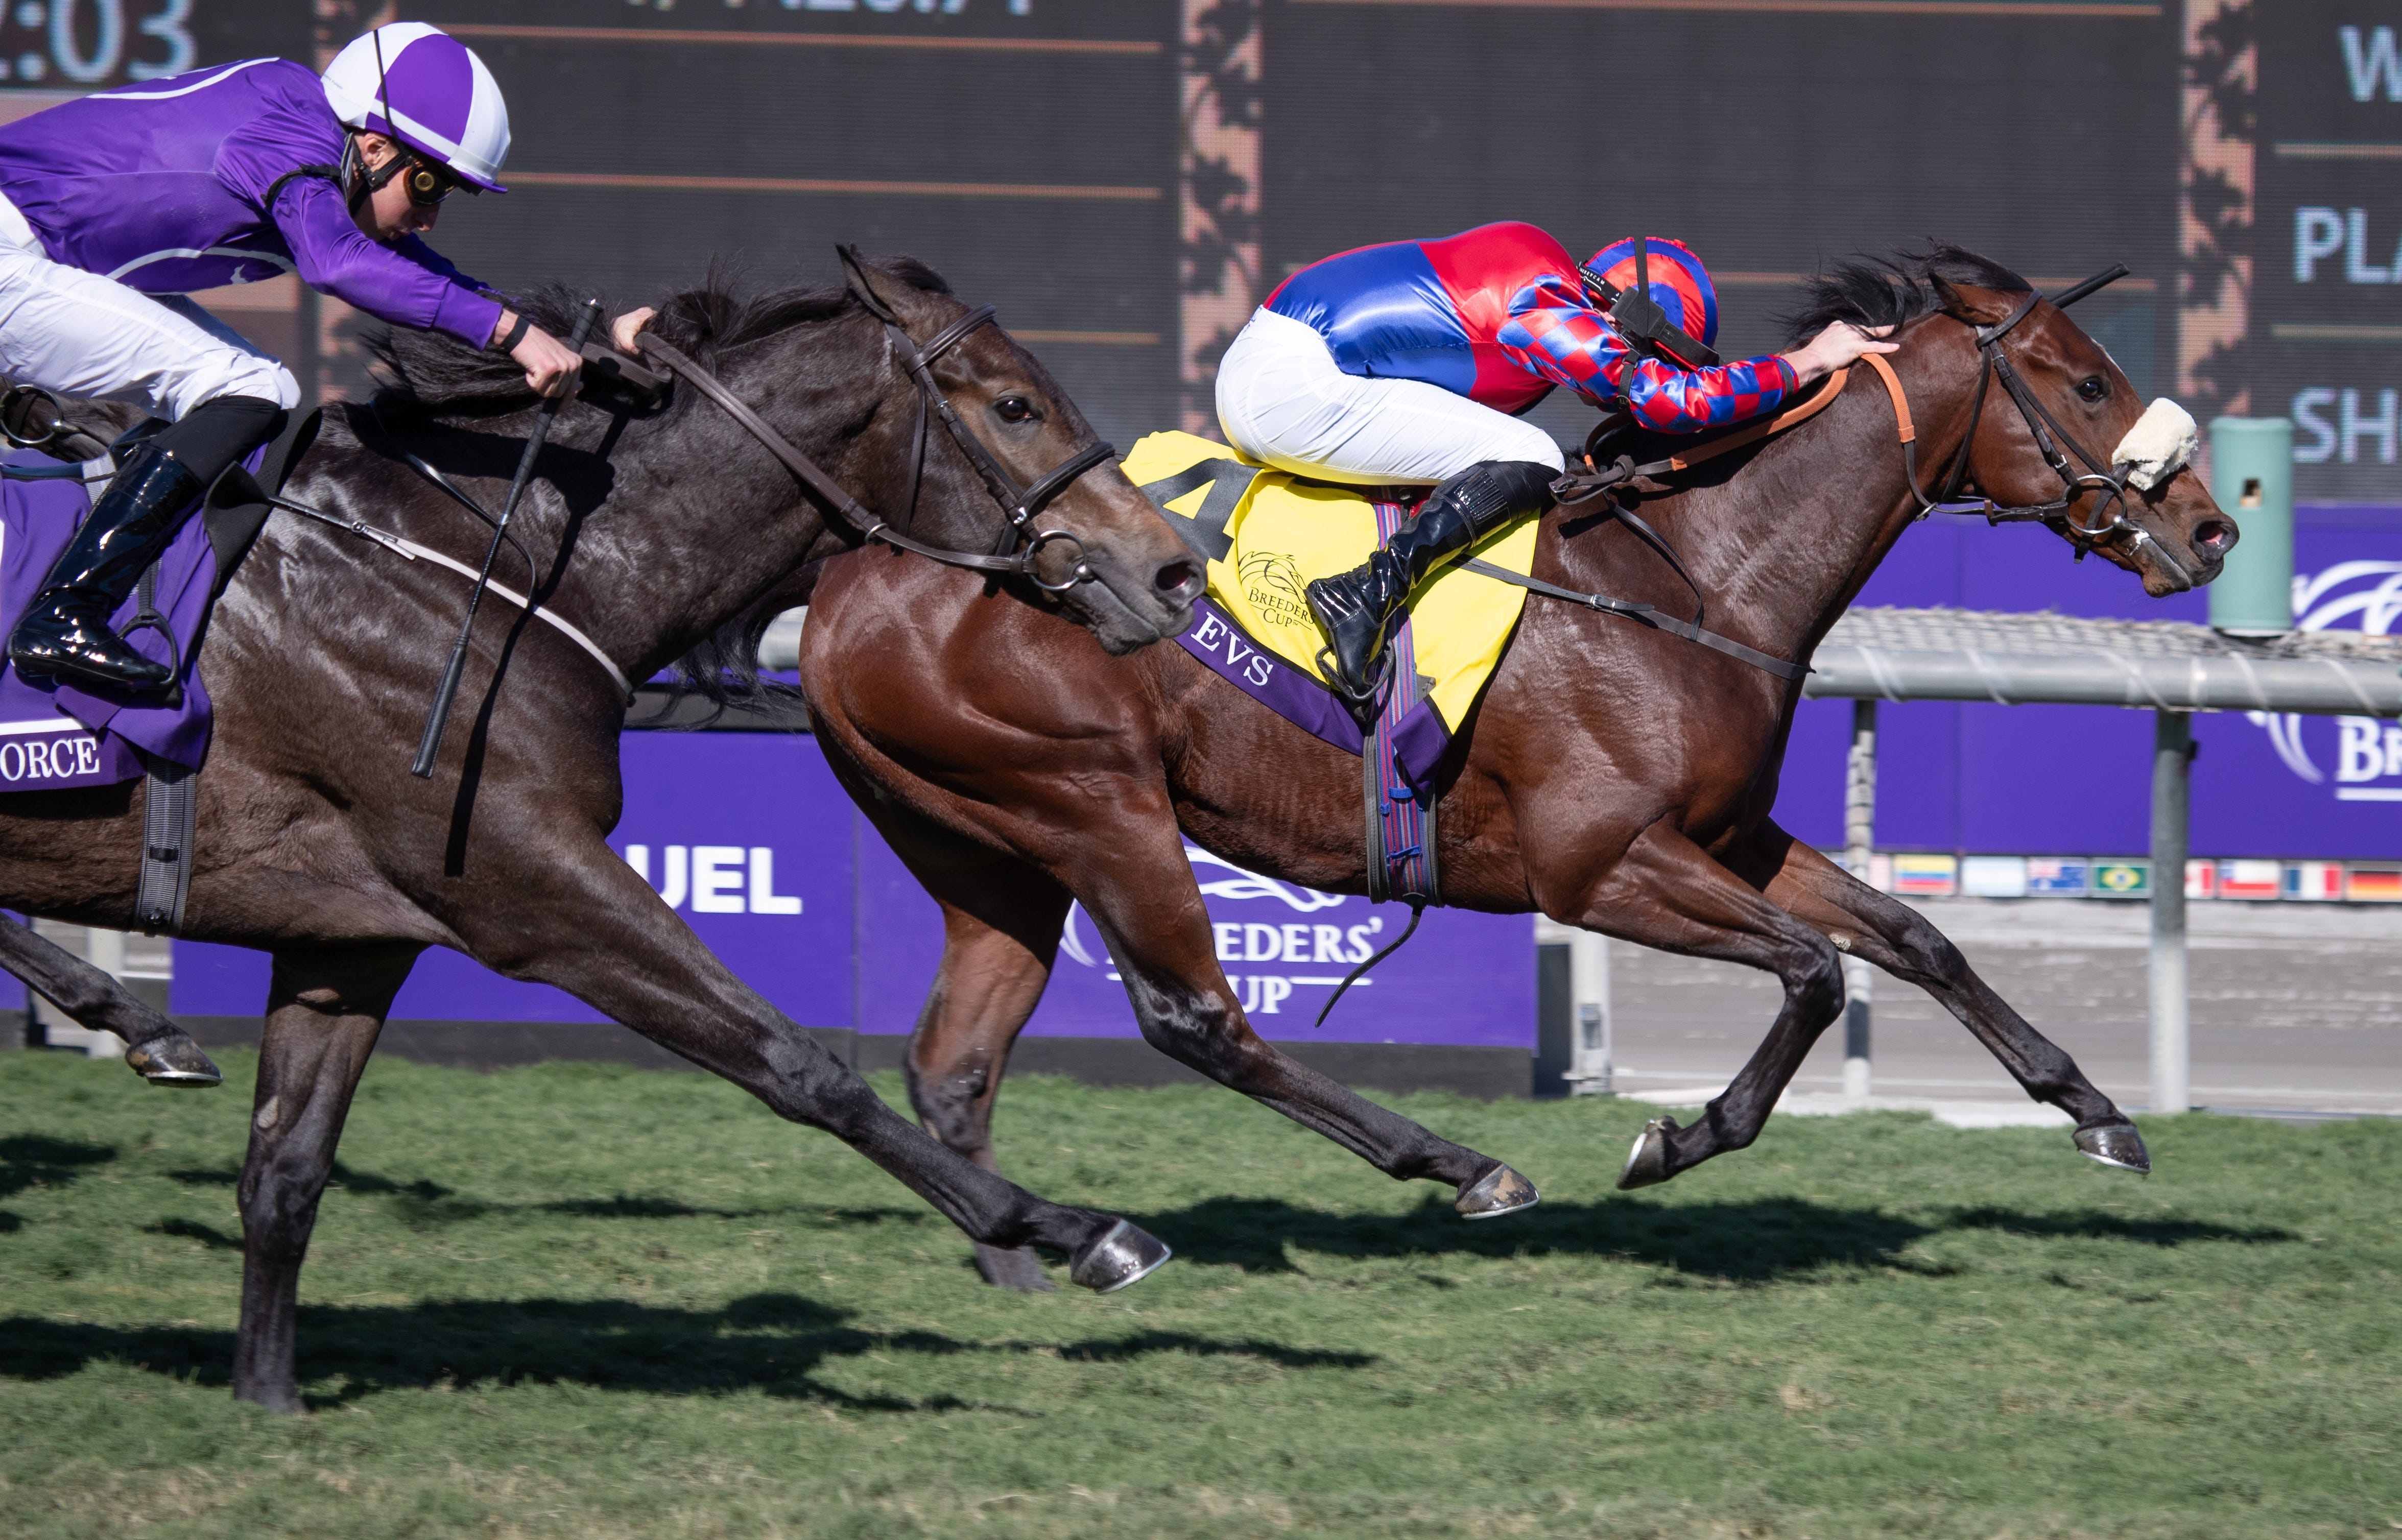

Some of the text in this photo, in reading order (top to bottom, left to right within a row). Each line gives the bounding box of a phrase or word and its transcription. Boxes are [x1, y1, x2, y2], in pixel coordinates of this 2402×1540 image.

[2295, 207, 2402, 283] PL
[1137, 458, 1265, 564] 4
[1191, 611, 1273, 686] EVS
[1226, 975, 1292, 1014] UP
